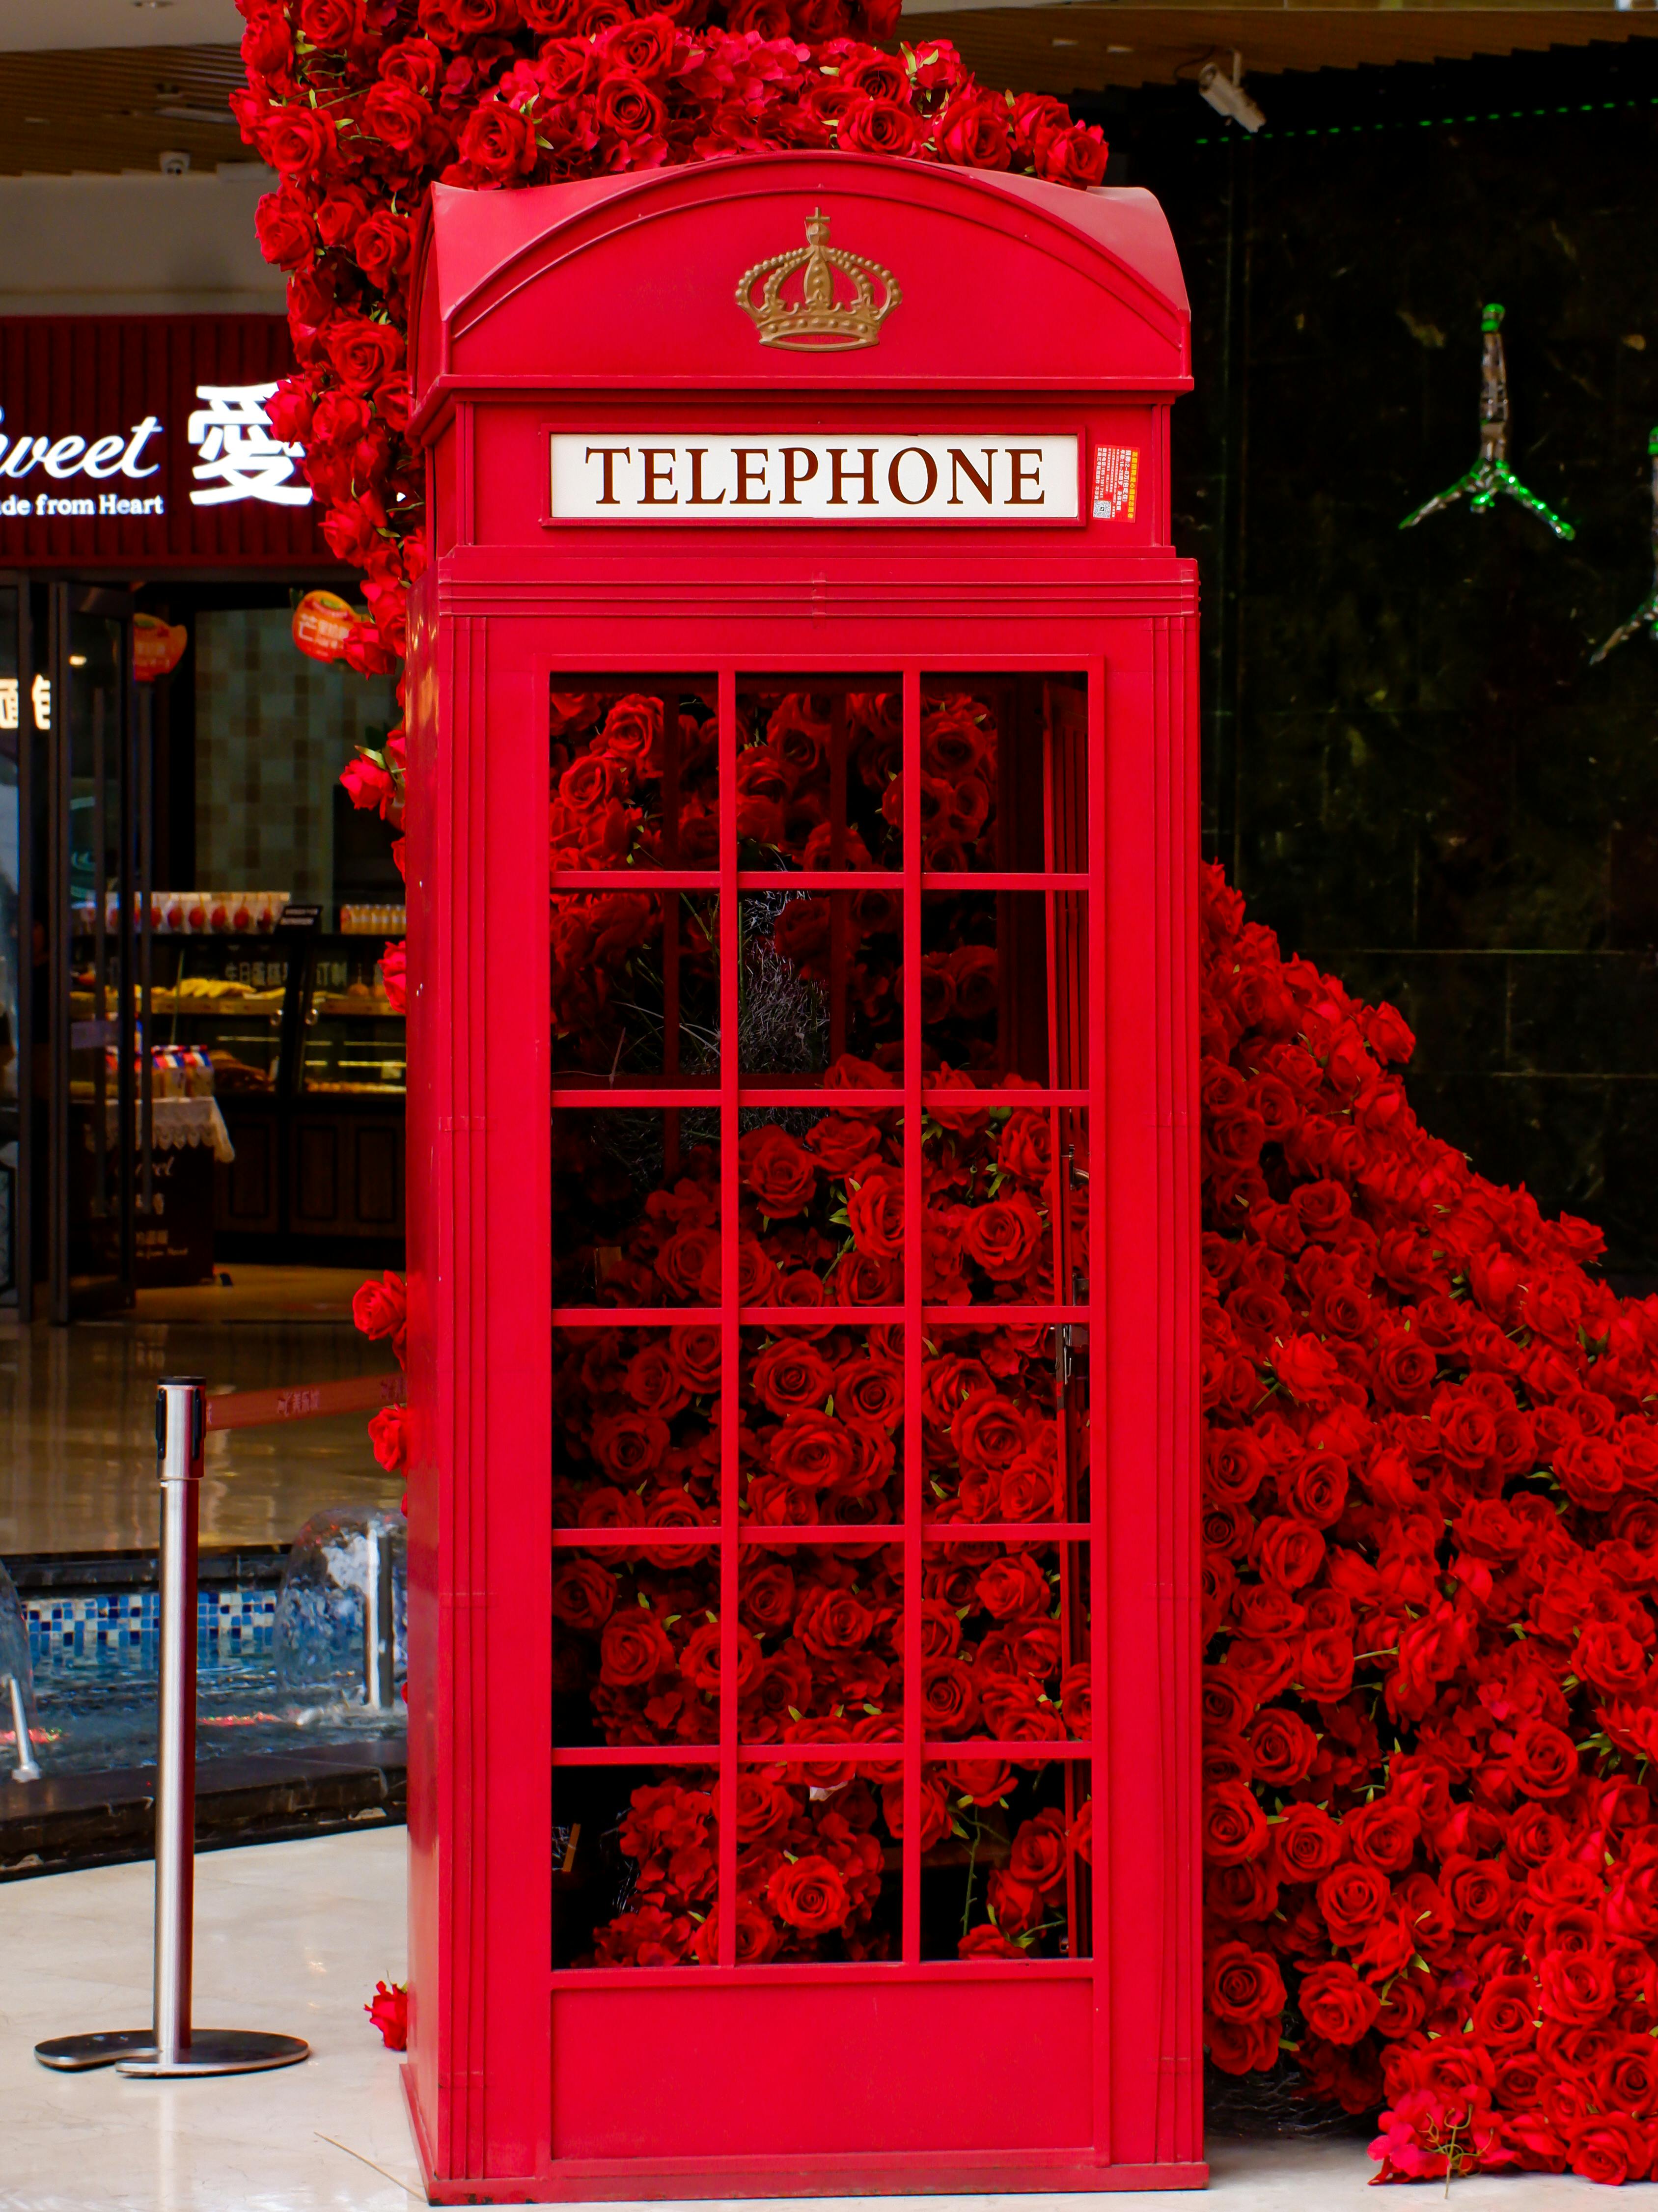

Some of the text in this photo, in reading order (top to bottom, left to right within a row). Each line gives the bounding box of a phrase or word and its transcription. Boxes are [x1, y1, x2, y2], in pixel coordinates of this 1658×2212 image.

[0, 406, 163, 478] weet
[188, 379, 313, 506] 愛
[0, 494, 164, 516] de from Heart
[585, 446, 1045, 505] TELEPHONE
